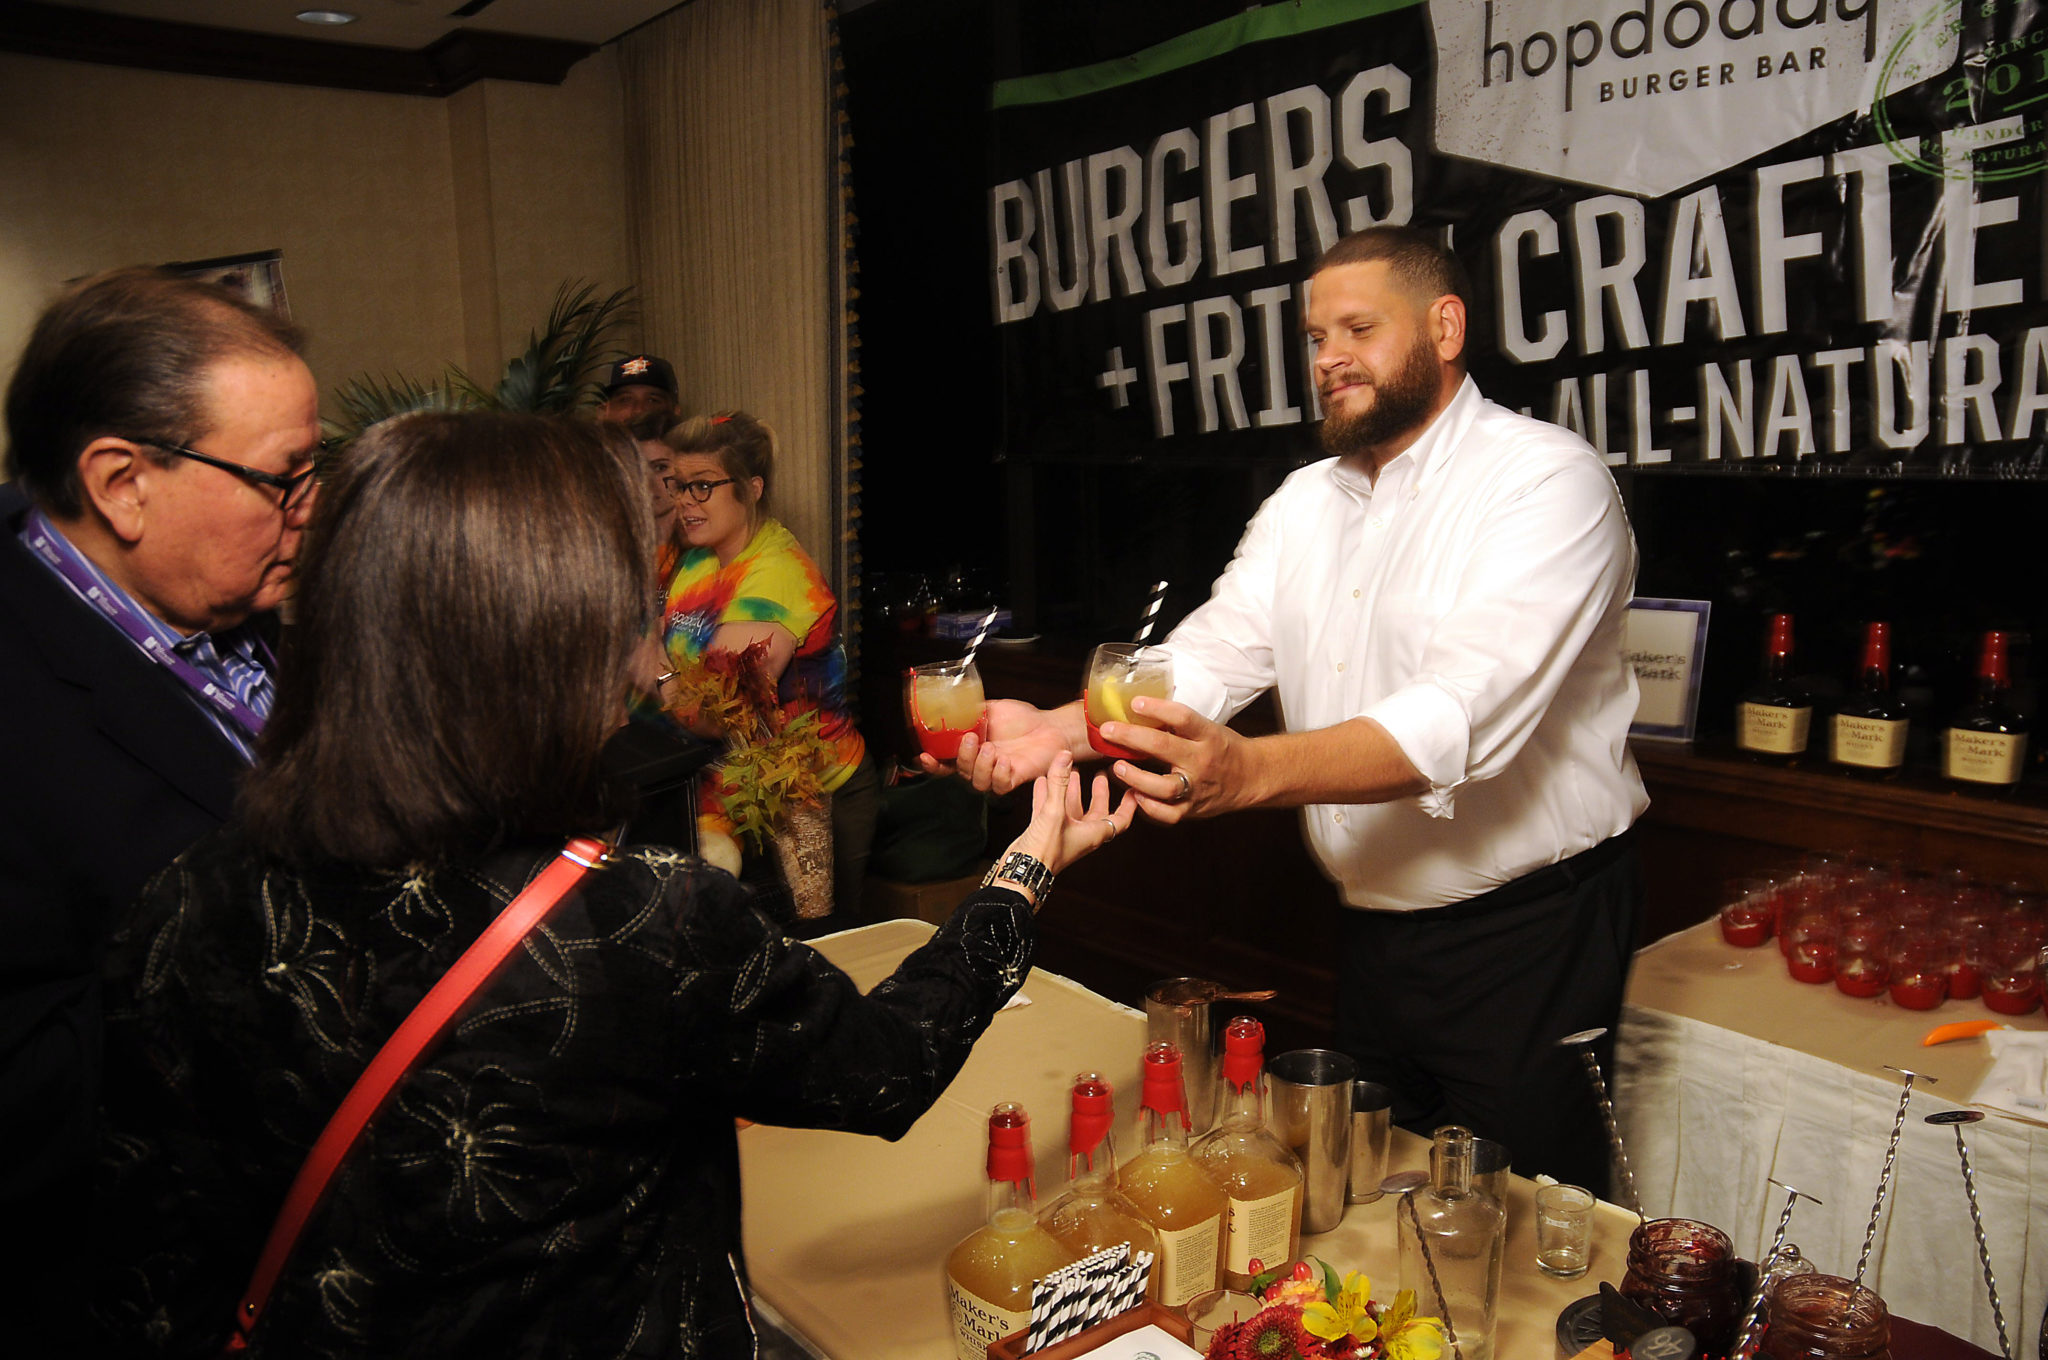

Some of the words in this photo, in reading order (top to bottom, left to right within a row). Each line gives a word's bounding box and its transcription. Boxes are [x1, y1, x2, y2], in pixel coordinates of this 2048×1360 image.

[1482, 0, 1878, 112] hopdoy
[1600, 63, 1735, 102] BURGER
[1756, 47, 1827, 78] BAR
[994, 63, 1413, 324] BURGERS
[1920, 139, 1951, 158] ALL
[1500, 115, 2026, 363] CRAFTE
[1103, 280, 1324, 437] +FRI
[1521, 325, 2048, 466] ALL-NATURA
[949, 1284, 1009, 1331] Maker's
